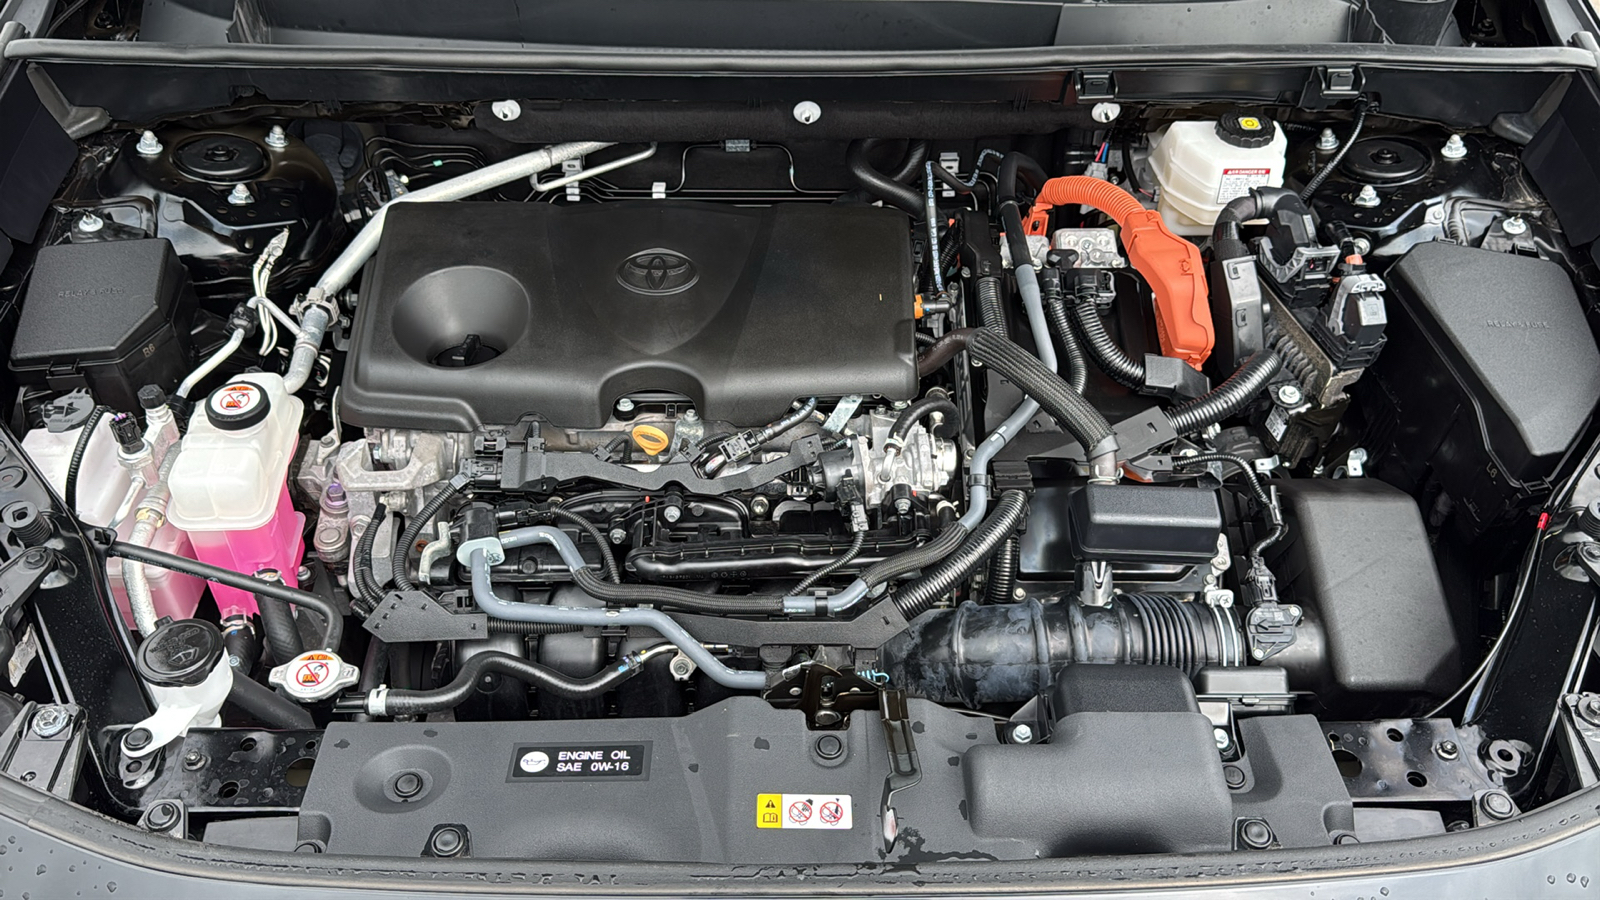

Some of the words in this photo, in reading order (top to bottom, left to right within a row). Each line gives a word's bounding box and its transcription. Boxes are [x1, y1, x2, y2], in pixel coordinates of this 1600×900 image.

[58, 289, 90, 298] RELAY
[1486, 319, 1516, 329] RELAY
[557, 750, 604, 761] ENGINE
[610, 749, 632, 760] OIL
[556, 762, 583, 772] SAE
[590, 761, 630, 772] 0W-16
